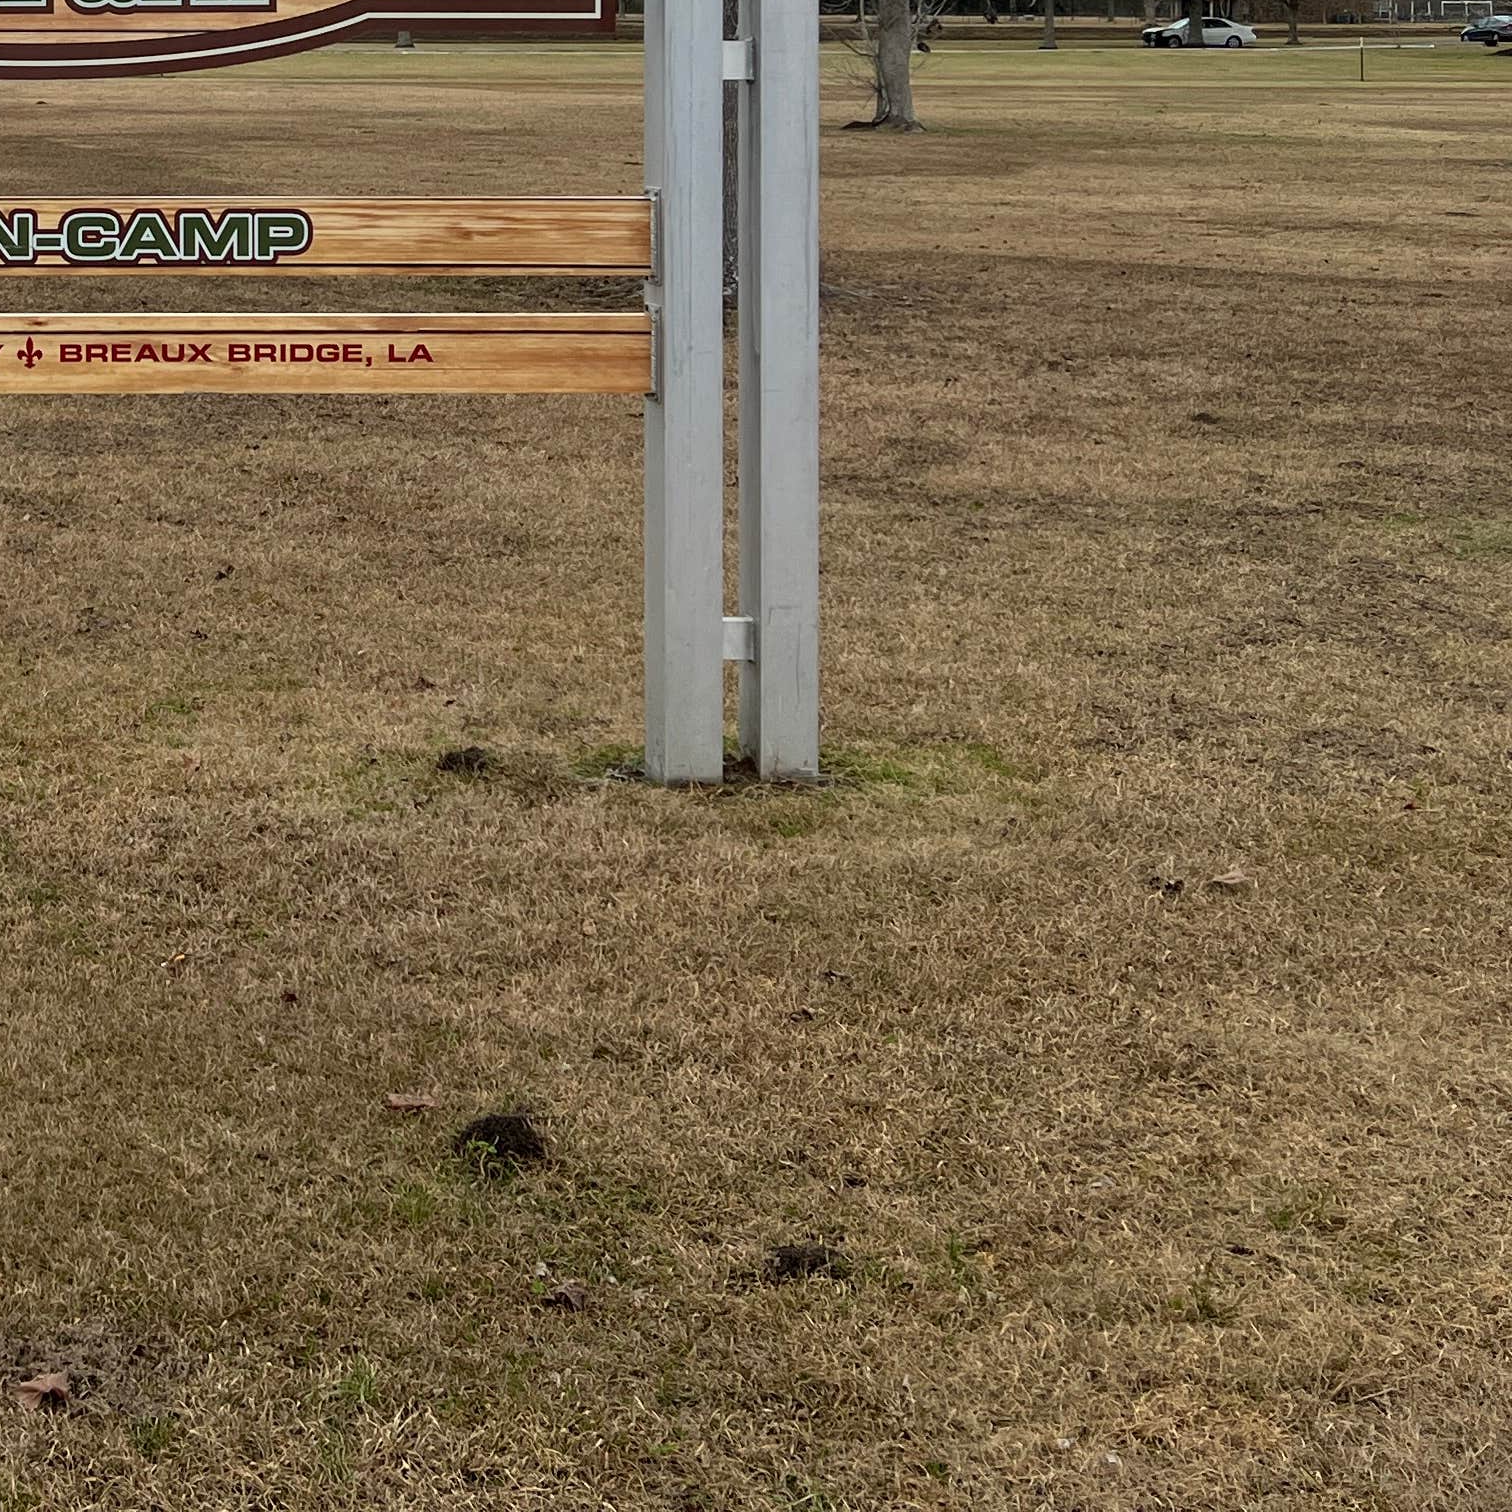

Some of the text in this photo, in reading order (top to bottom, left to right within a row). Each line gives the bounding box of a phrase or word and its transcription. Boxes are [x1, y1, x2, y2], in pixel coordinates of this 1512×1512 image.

[58, 343, 213, 363] BREAUX
[227, 343, 374, 368] BRIDGE,
[387, 343, 434, 363] LA
